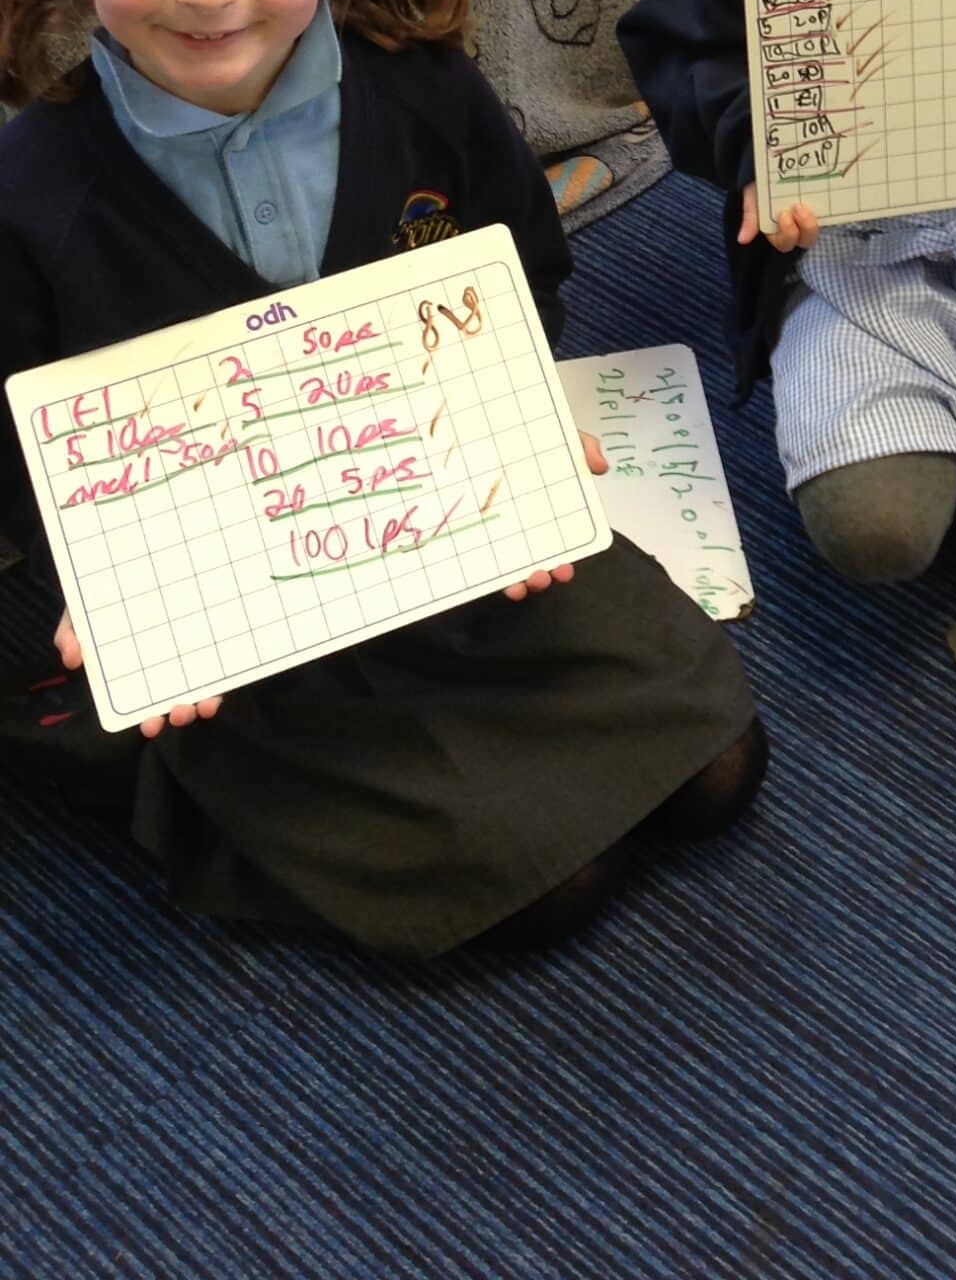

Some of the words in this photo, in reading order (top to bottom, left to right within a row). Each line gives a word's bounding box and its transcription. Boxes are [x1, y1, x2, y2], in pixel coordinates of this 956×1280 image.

[761, 21, 773, 35] 5
[246, 302, 298, 332] odh
[218, 355, 254, 385] 2
[241, 387, 263, 420] 5
[66, 433, 88, 468] 5
[245, 446, 279, 481] 10
[263, 484, 306, 518] 20
[290, 524, 349, 568] 100
